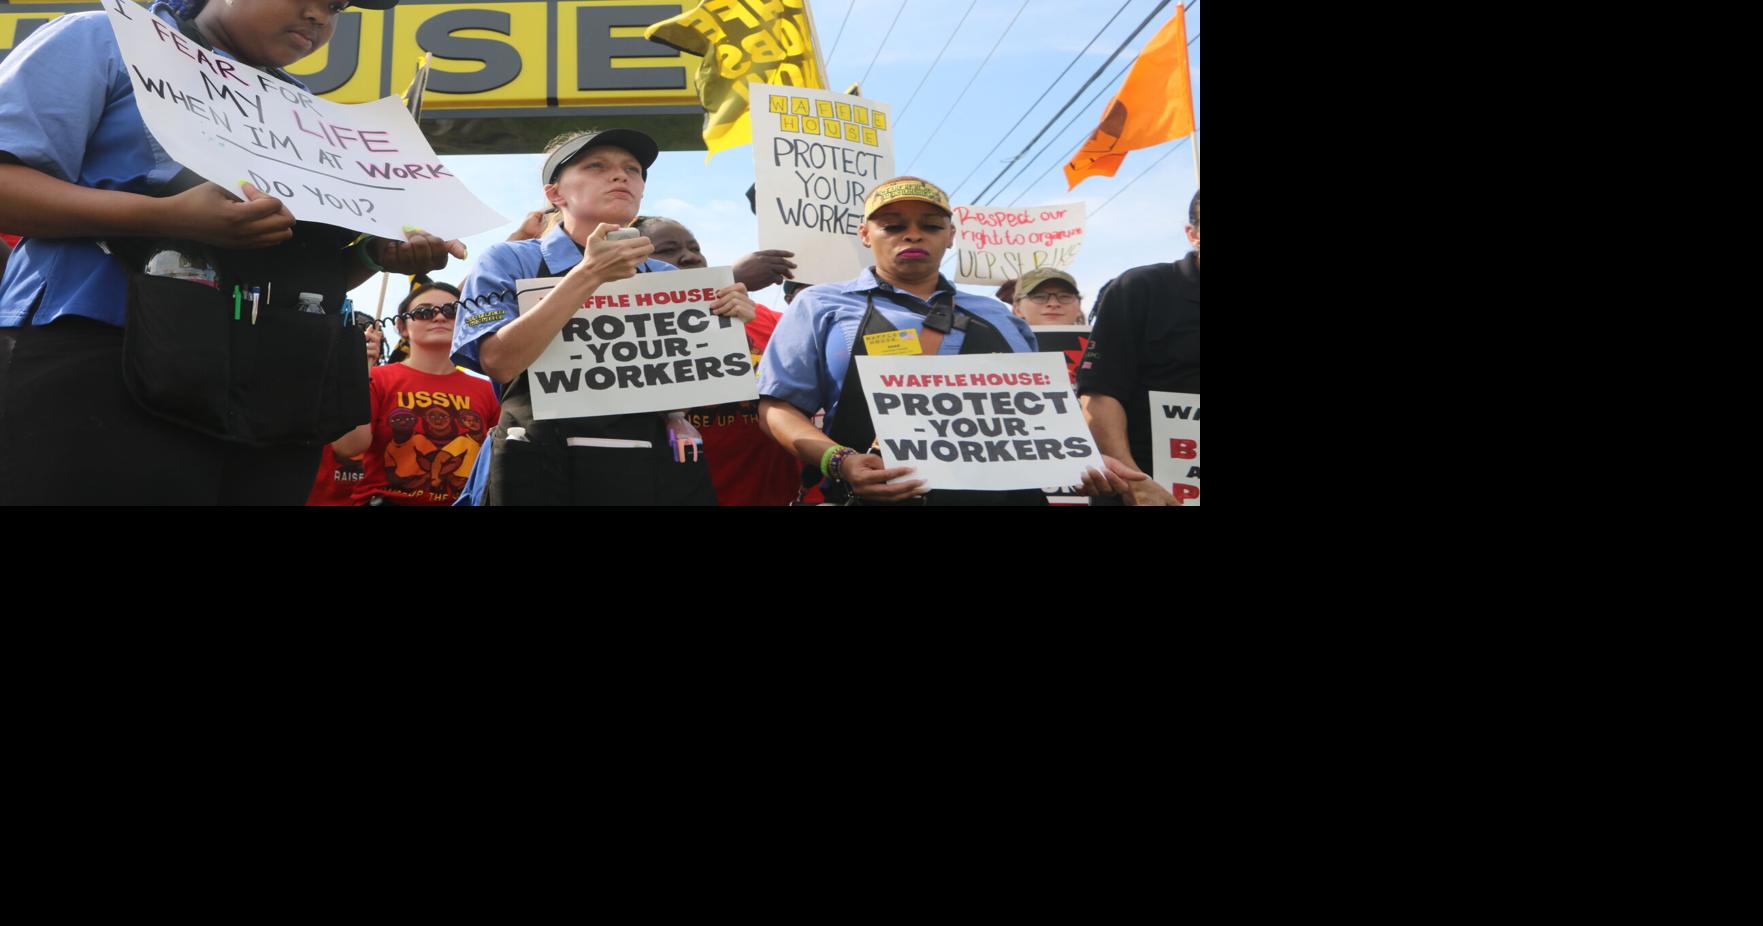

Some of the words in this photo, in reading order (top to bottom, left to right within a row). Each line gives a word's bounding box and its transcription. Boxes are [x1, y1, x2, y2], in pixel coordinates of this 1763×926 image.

[152, 19, 249, 86] FEAR
[257, 75, 322, 117] FOR
[132, 64, 232, 133] WHEN
[244, 124, 302, 160] I'M
[319, 149, 343, 170] AT
[200, 71, 264, 124] MY
[293, 110, 399, 152] LIFE
[769, 96, 886, 130] WAFFLE
[781, 115, 877, 145] HOUSE
[774, 137, 883, 180] PROTECT
[248, 170, 294, 198] DO
[303, 185, 376, 222] YOU?
[795, 170, 865, 206] YOUR
[953, 207, 1036, 227] Respect
[1040, 209, 1068, 221] our
[961, 229, 1003, 250] right
[1005, 230, 1026, 245] to
[958, 248, 997, 280] ULP
[578, 295, 630, 309] FFLE
[562, 308, 734, 342] ROTECT
[535, 353, 750, 394] WORKERS
[880, 374, 966, 387] WAFFLE
[971, 373, 1050, 386] HOUSE:
[397, 391, 470, 410] USSW
[873, 391, 1068, 416] PROTECT
[688, 415, 709, 428] ISE
[718, 416, 735, 427] UP
[742, 415, 759, 423] TH
[884, 437, 1092, 463] WORKERS
